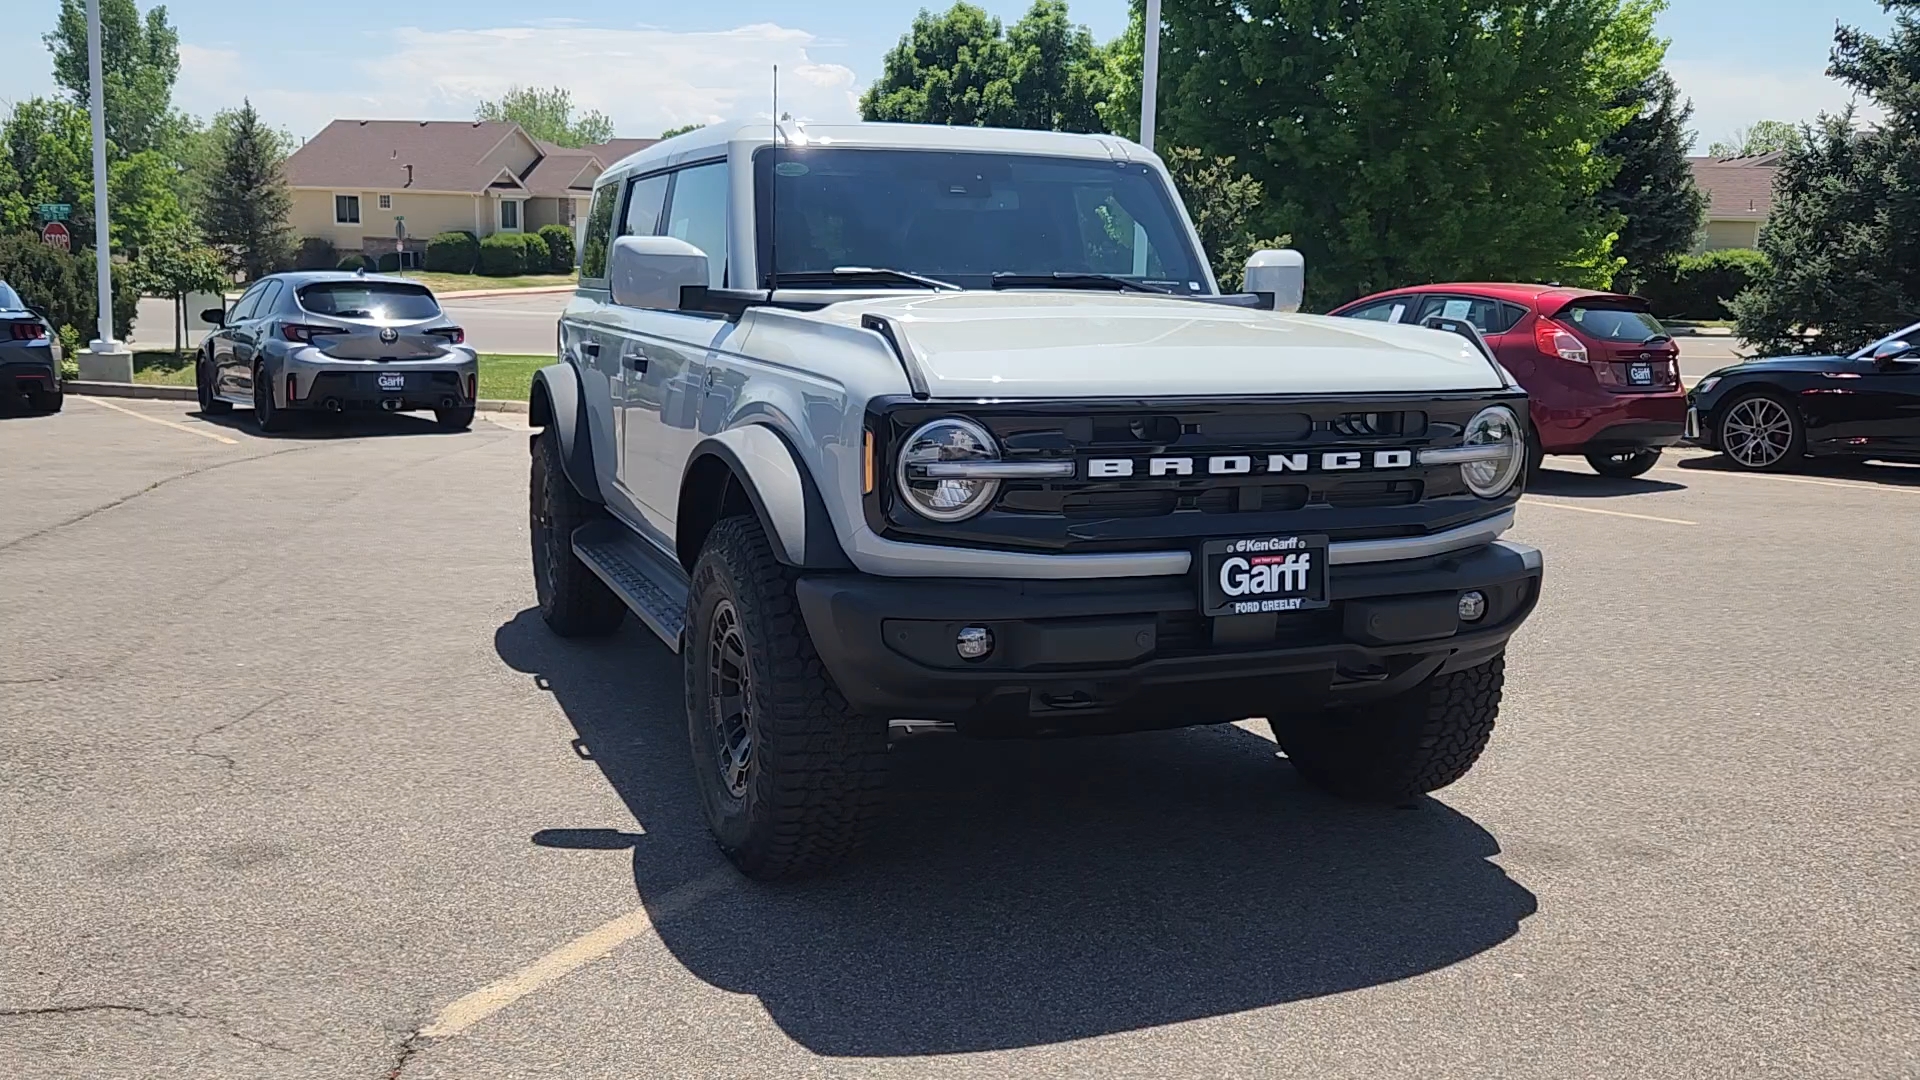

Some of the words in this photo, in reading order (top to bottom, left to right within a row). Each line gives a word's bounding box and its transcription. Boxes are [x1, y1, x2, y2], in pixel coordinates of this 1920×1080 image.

[44, 234, 68, 247] STOP
[378, 376, 404, 387] Garff
[1087, 450, 1412, 477] BRONCO
[1246, 540, 1269, 552] Ken
[1269, 536, 1298, 550] Garff
[1220, 552, 1310, 597] Garff
[1235, 600, 1260, 613] FORD
[1261, 598, 1302, 612] GREELEY
